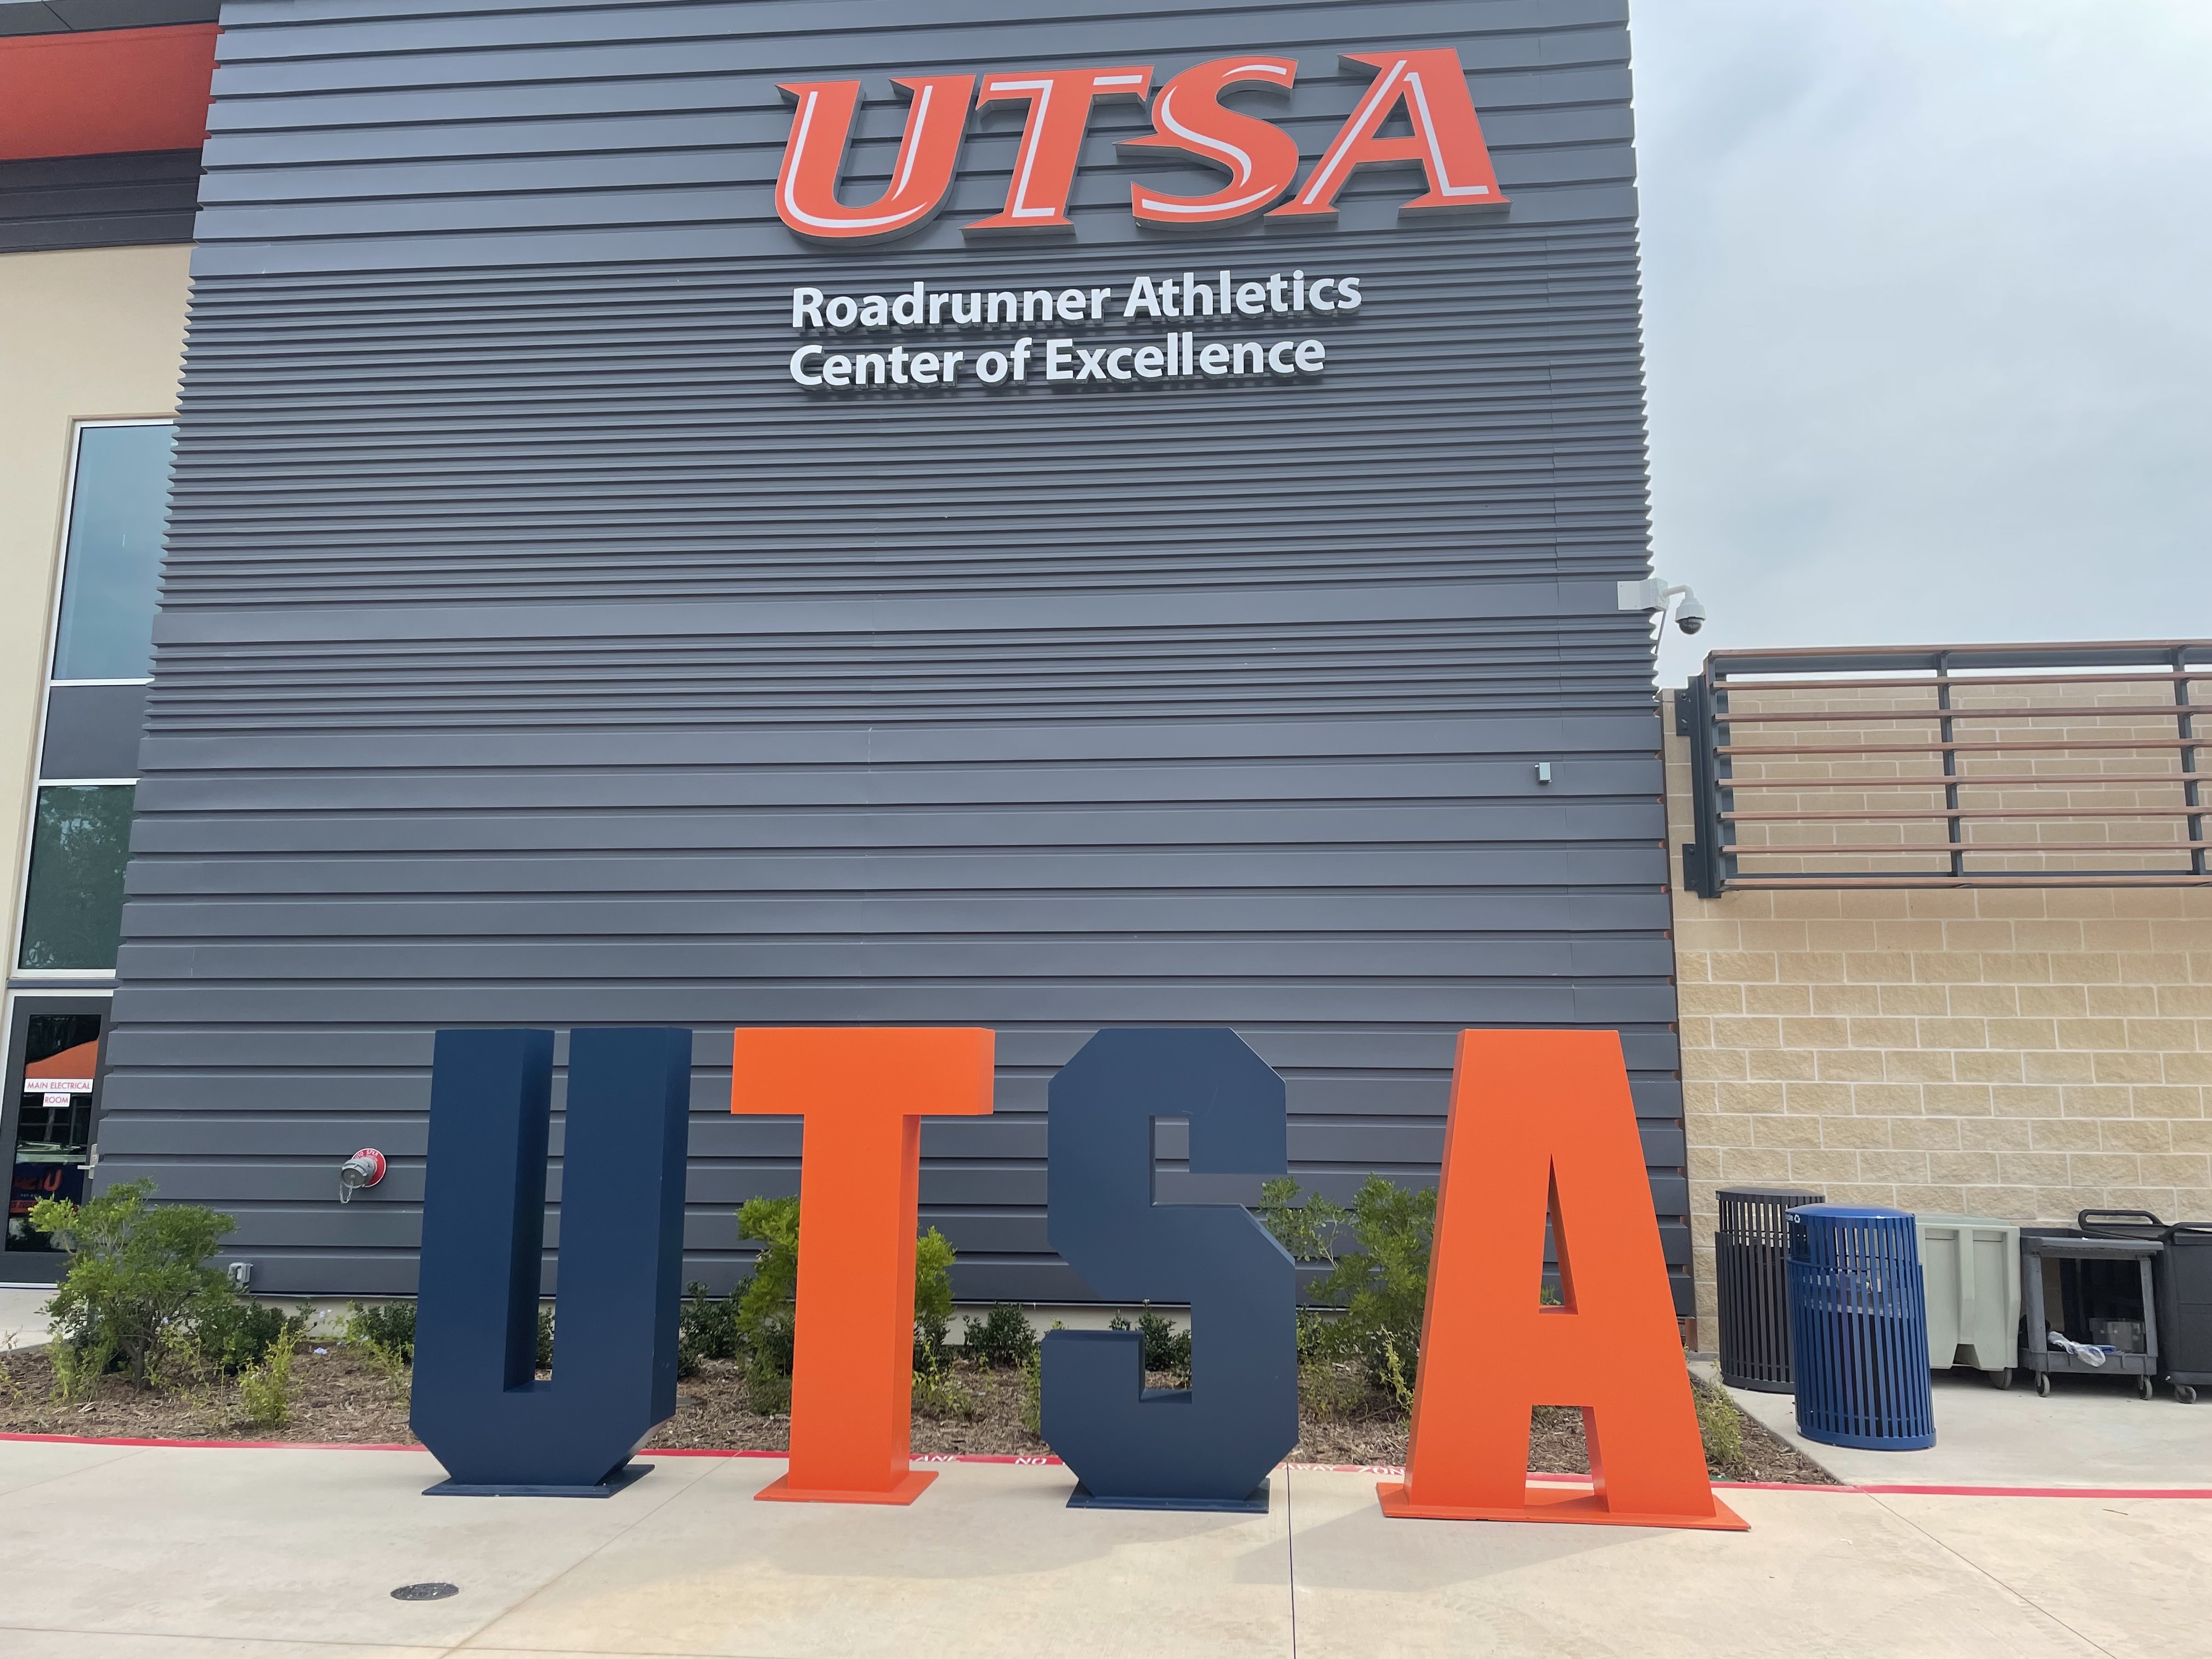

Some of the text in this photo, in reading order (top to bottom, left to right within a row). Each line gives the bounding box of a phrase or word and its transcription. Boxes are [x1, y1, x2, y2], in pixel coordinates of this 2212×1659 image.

[775, 47, 1511, 239] UTSA
[792, 269, 1362, 328] Roadrunner Athletics
[790, 331, 1325, 386] Center of Excellence
[410, 1028, 1750, 1528] UTSA
[1015, 1457, 1047, 1465] NO
[1281, 1462, 1335, 1472] AWAY
[1357, 1466, 1405, 1476] ZON
